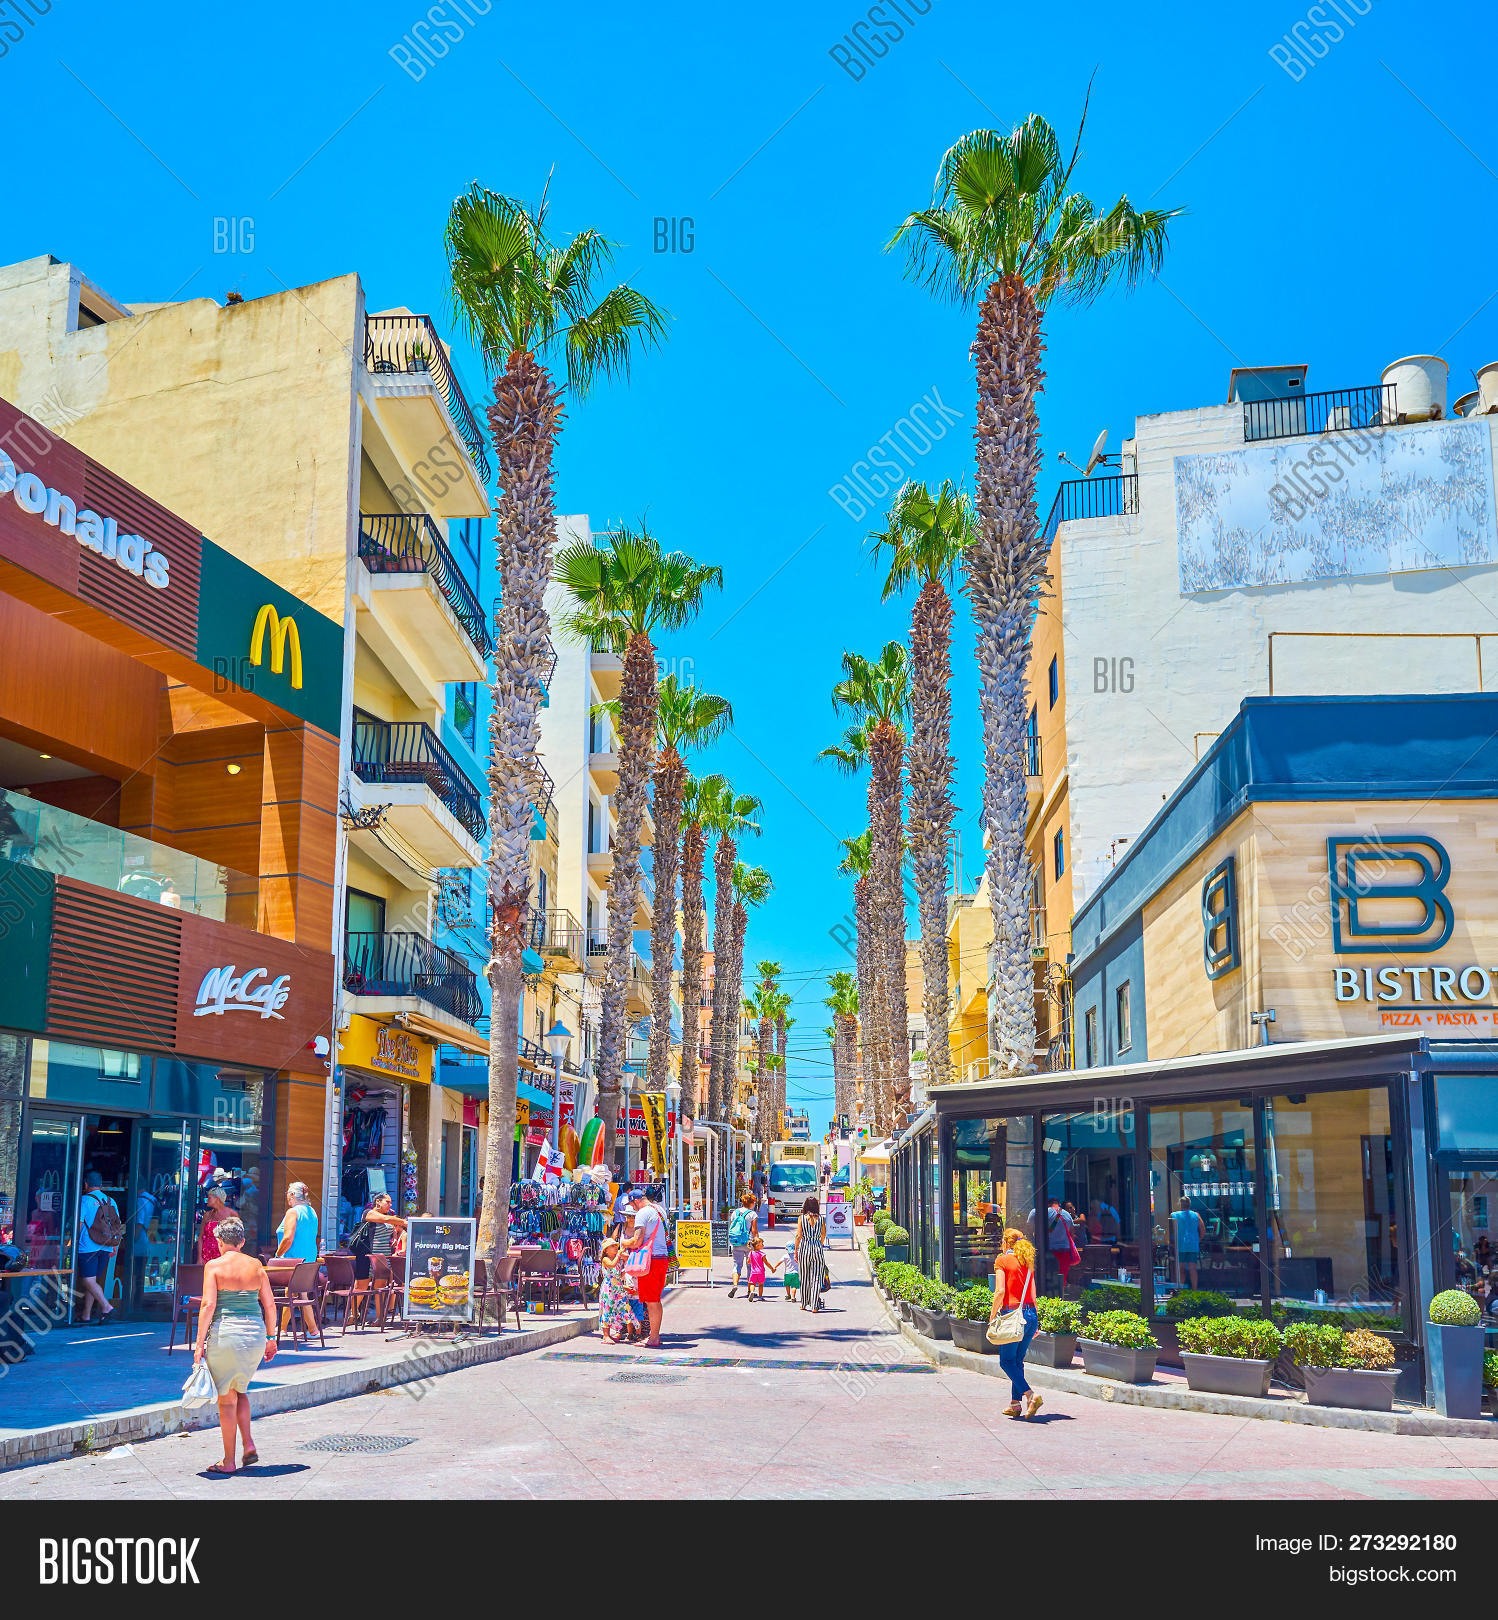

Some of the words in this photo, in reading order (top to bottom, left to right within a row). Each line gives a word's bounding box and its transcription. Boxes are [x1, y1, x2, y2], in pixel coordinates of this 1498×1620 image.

[1333, 966, 1498, 1002] BISTRO
[1381, 1013, 1422, 1026] PIZZA
[1436, 1012, 1478, 1026] PASTA
[647, 1095, 664, 1165] BARBER
[678, 1229, 710, 1239] BARBER
[442, 1243, 454, 1251] Big
